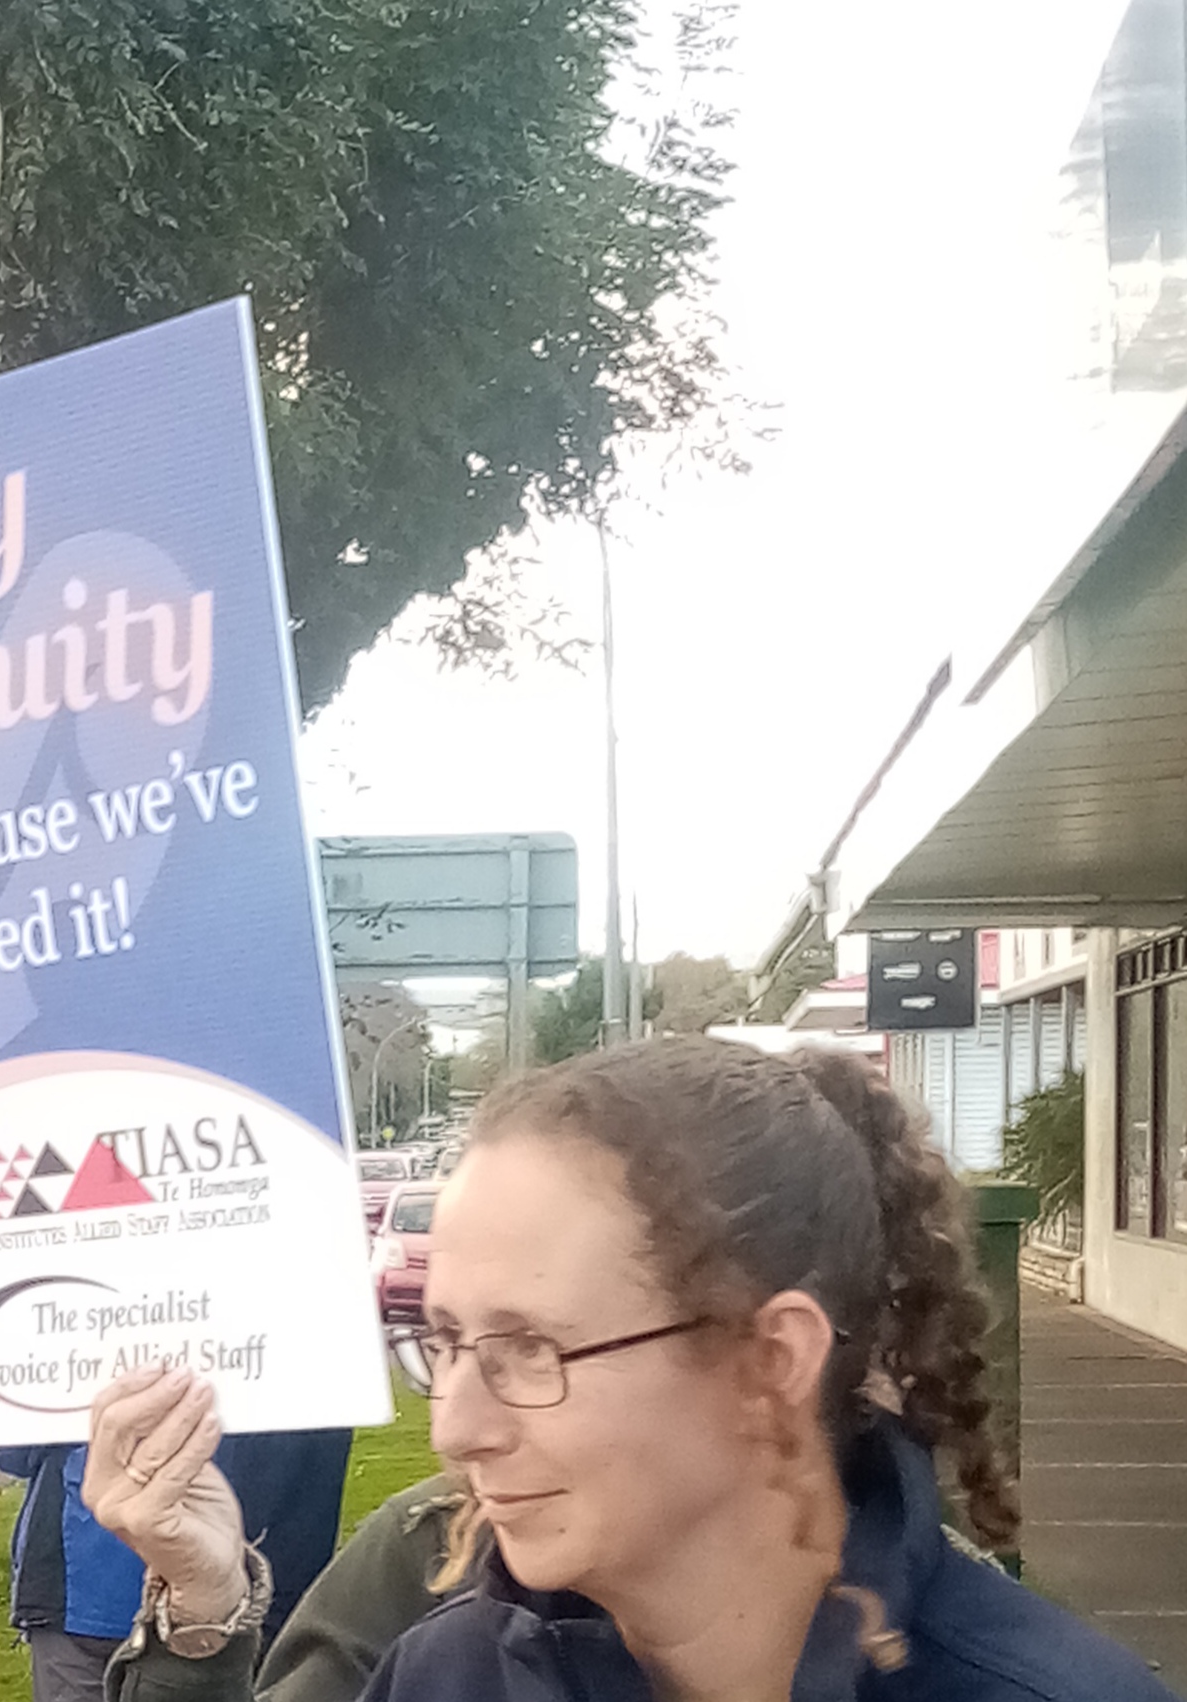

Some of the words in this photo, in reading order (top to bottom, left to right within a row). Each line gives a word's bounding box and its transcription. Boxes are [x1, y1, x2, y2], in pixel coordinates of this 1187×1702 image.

[88, 750, 259, 843] we've
[71, 876, 136, 960] it!
[32, 1301, 78, 1335] The
[85, 1289, 211, 1341] specialist
[66, 1348, 102, 1393] for
[199, 1333, 267, 1381] Staff
